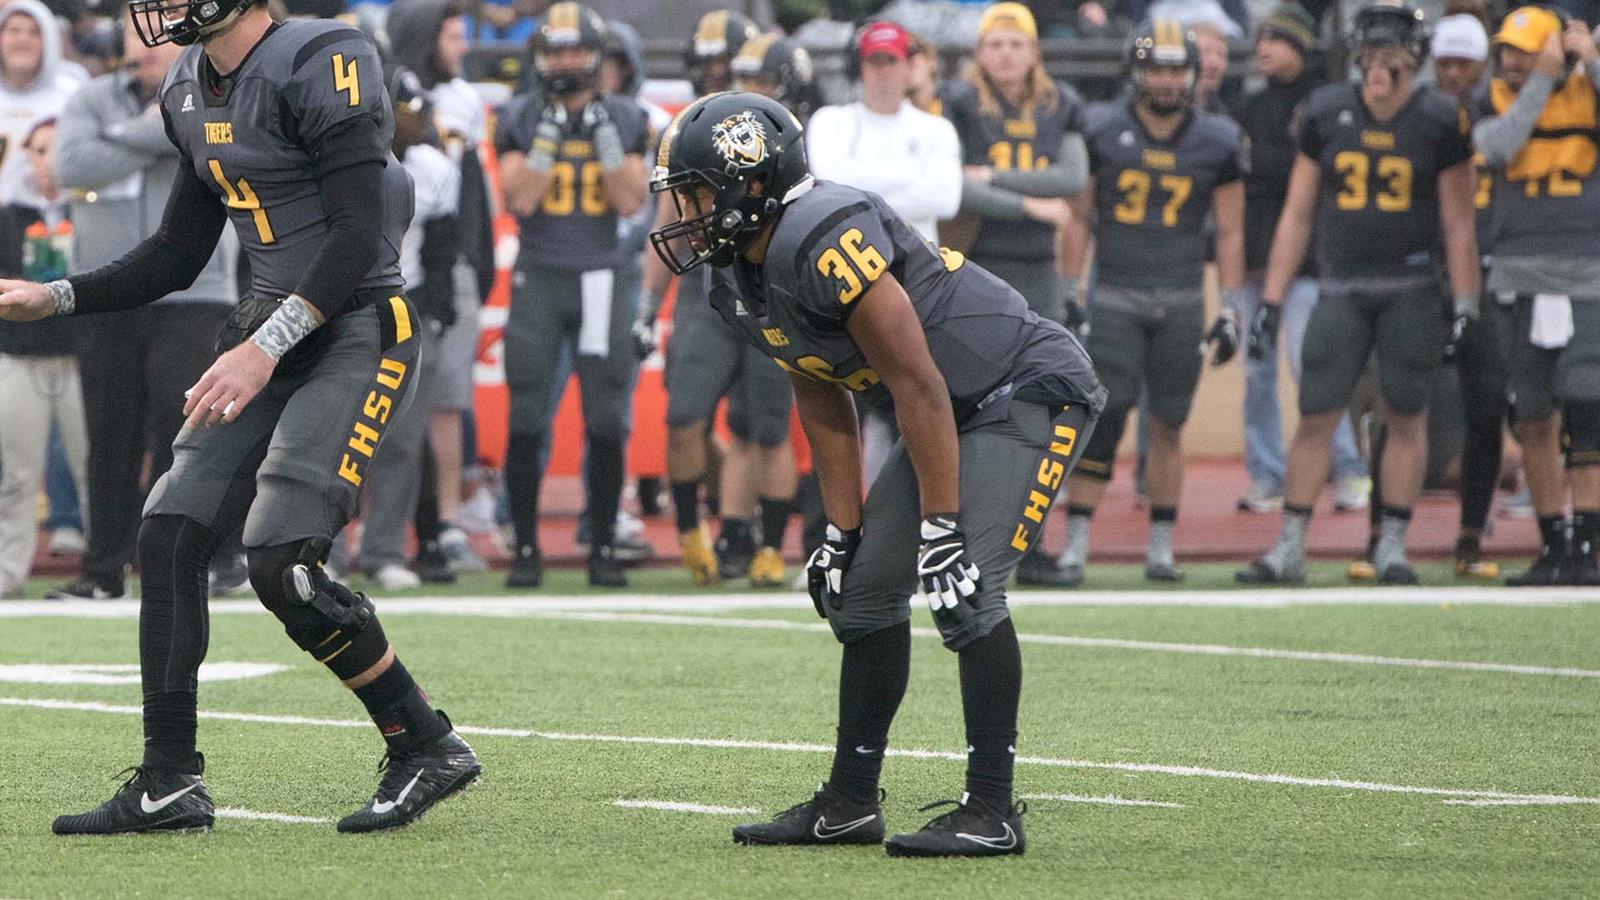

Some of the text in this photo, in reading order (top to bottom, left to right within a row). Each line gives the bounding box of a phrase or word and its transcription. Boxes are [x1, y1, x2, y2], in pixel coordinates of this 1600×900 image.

[332, 53, 361, 107] 4
[204, 122, 233, 144] TIGERS
[207, 158, 276, 244] 4
[1113, 169, 1193, 227] 37
[1334, 150, 1413, 212] 33
[816, 227, 888, 304] 36
[338, 358, 406, 487] FHSU
[1010, 424, 1077, 552] FHSU
